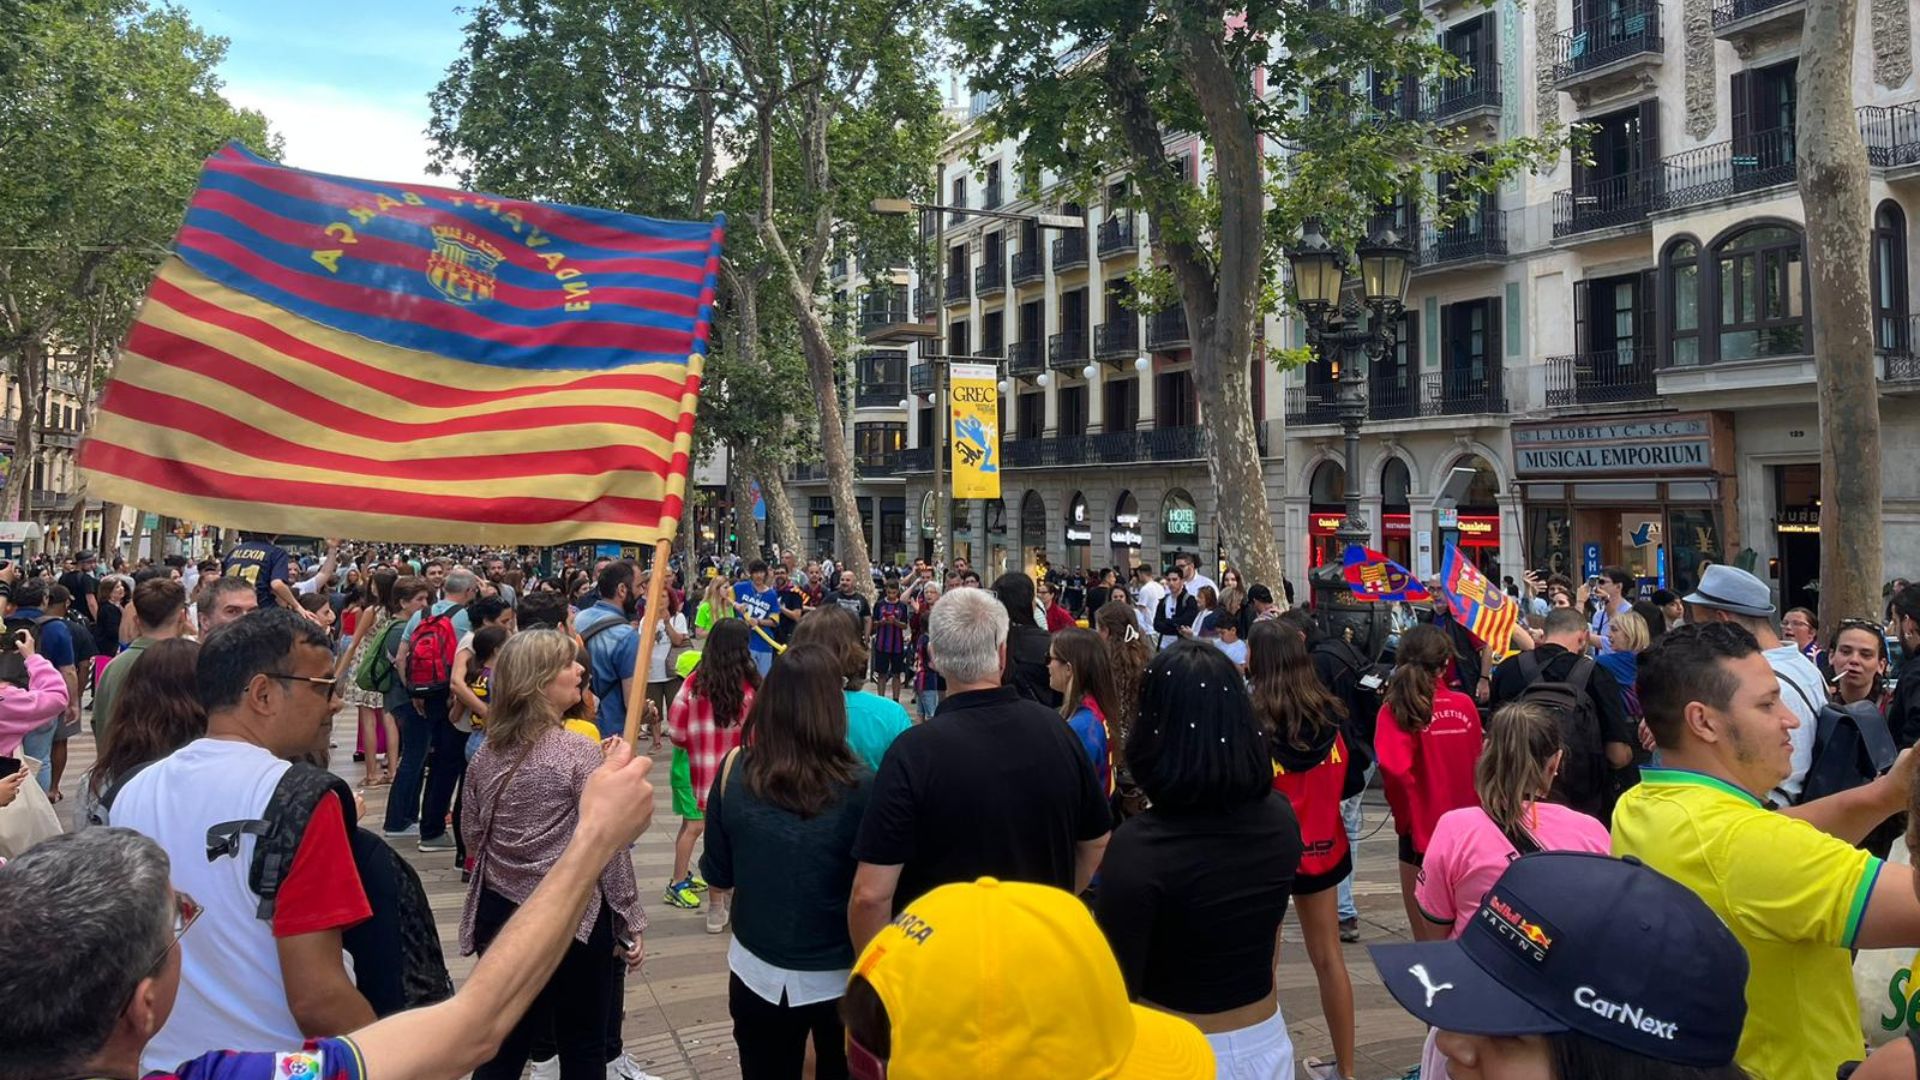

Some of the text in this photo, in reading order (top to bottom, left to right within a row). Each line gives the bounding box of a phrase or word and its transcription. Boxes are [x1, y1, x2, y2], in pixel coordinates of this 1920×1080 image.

[953, 386, 995, 403] GREC
[1551, 427, 1602, 440] LLOBET
[1609, 425, 1616, 437] Y
[1525, 445, 1702, 468] MUSICAL EMPORIUM
[1169, 509, 1194, 521] HOTEL
[1168, 521, 1195, 534] LLORET
[232, 549, 266, 561] ALEXIA
[742, 594, 771, 611] RAMS
[1482, 909, 1544, 962] RACING
[1573, 986, 1678, 1040] CarNext
